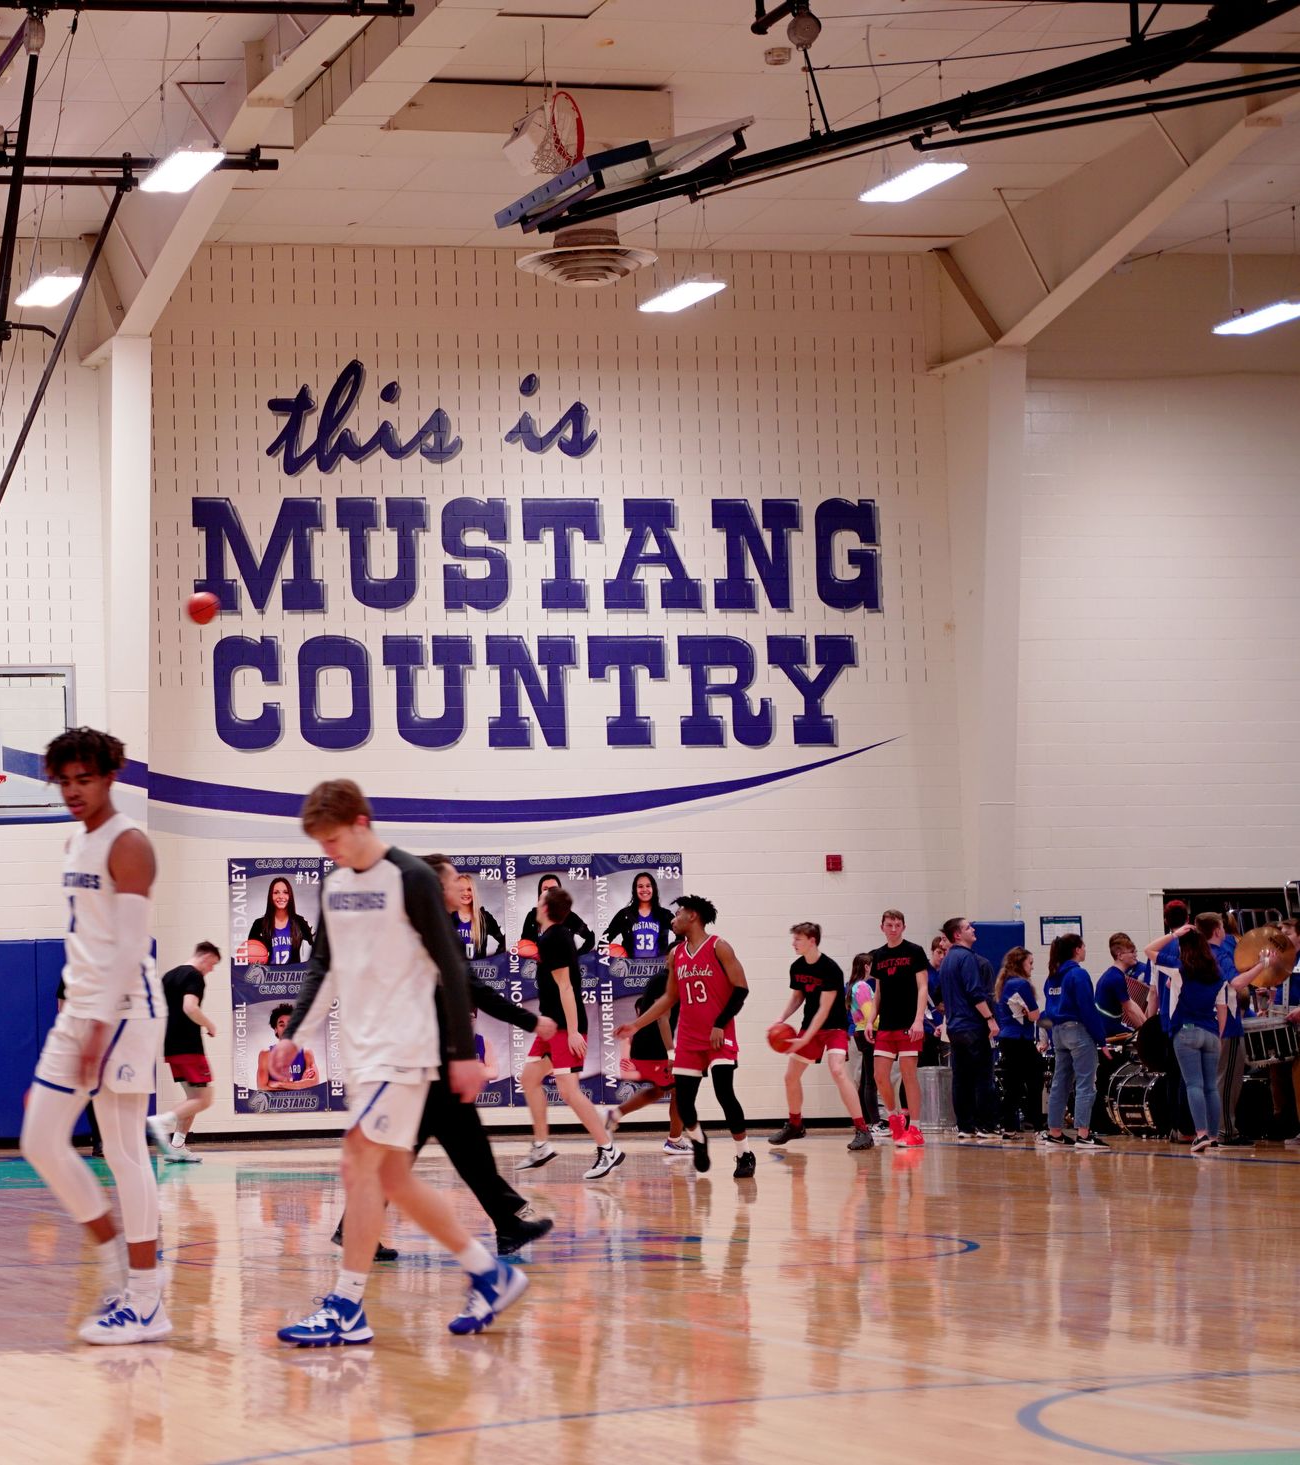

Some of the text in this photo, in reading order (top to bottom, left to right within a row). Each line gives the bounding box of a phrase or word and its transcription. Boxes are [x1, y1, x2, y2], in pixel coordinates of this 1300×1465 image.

[266, 358, 600, 476] this is
[192, 497, 883, 613] MUSTANG
[213, 635, 857, 751] COUNTRY
[255, 859, 283, 869] CLASS
[284, 859, 298, 869] OF
[529, 856, 557, 865] CLASS
[558, 856, 570, 865] OF
[618, 854, 646, 864] CLASS
[647, 854, 660, 864] OF
[295, 871, 319, 885] #12
[480, 868, 501, 881] #20
[568, 867, 590, 880] #21
[656, 866, 680, 880] #33
[231, 863, 248, 928] DANLEY
[596, 876, 610, 966] ASIA BRYANT
[636, 934, 654, 951] 33
[260, 986, 286, 995] CLASS
[686, 980, 707, 1004] 13
[235, 1002, 247, 1057] MITCHELL
[328, 998, 341, 1058] SANTIAG
[601, 980, 617, 1088] MAX MURRELL
[269, 1097, 317, 1110] MUSTANGS
